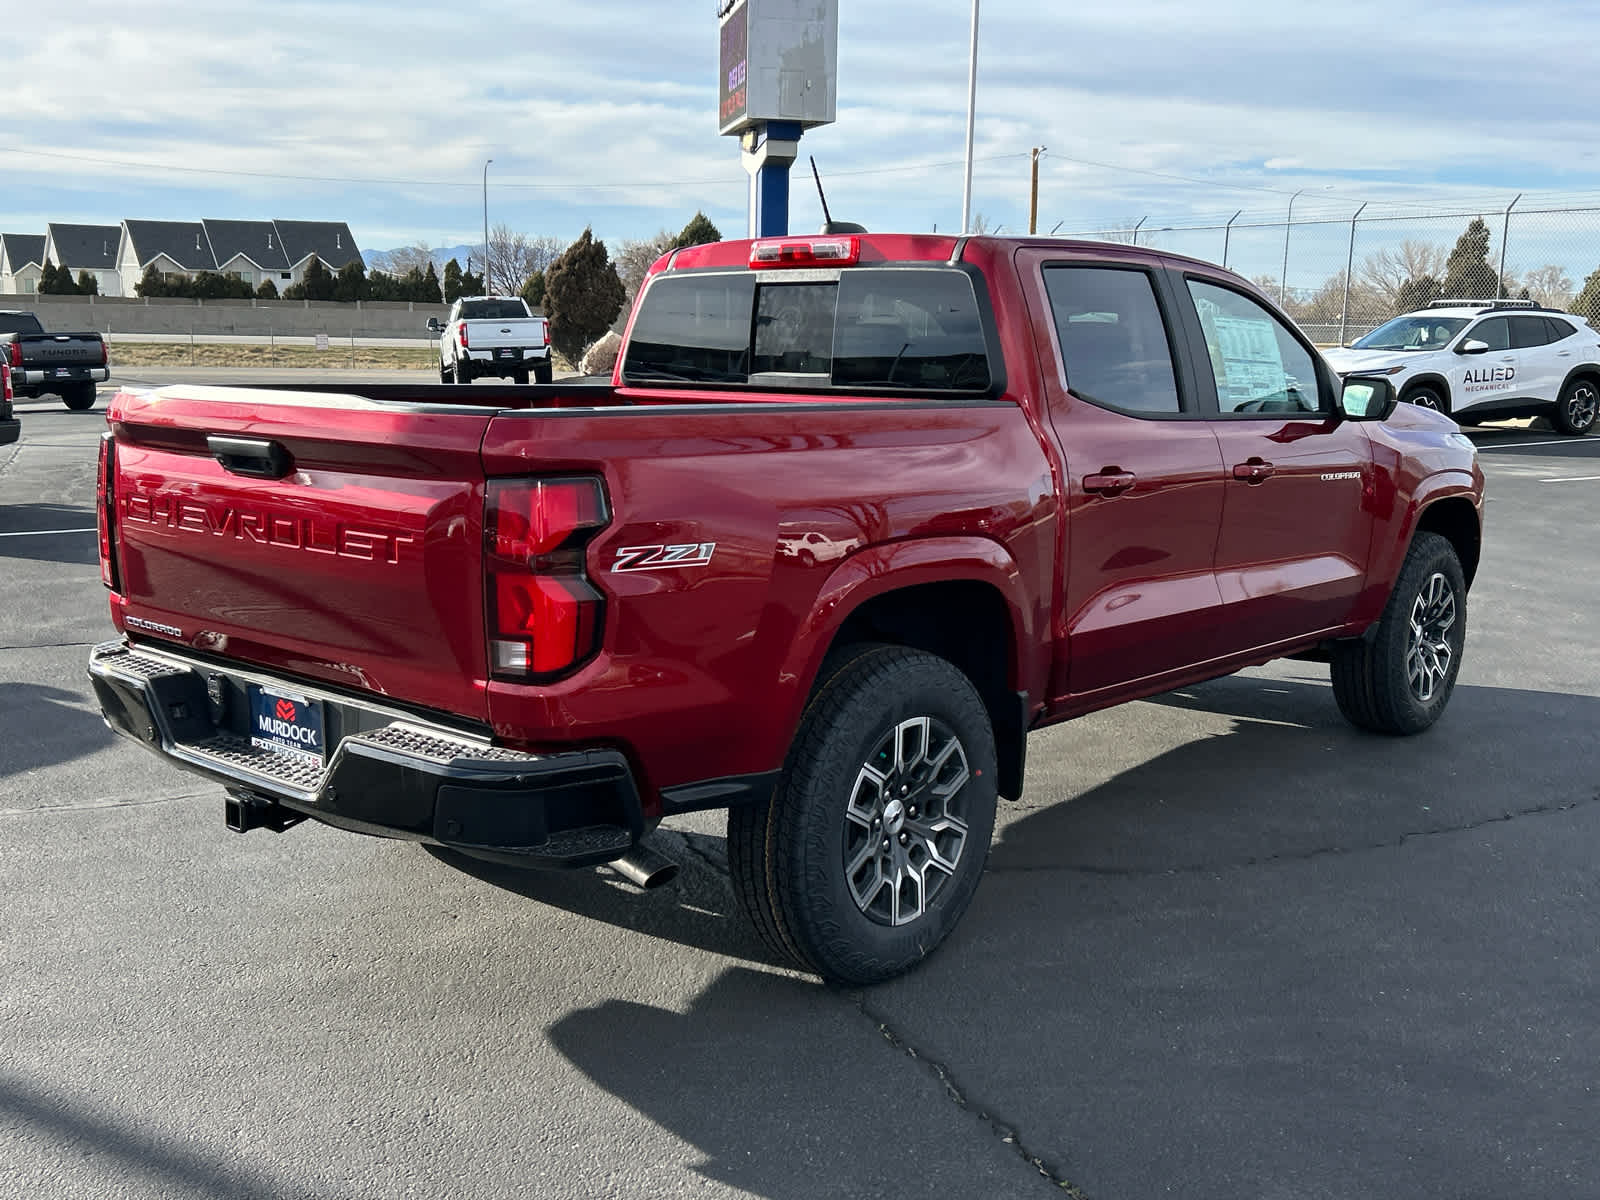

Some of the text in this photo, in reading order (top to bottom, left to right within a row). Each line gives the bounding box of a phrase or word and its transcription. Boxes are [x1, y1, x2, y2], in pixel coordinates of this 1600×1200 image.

[1463, 367, 1515, 384] ALLIED
[1465, 383, 1512, 392] MECHANICAL
[1320, 471, 1361, 481] COLORADO
[126, 496, 414, 565] CHEVROLET
[610, 542, 716, 573] Z71
[125, 615, 182, 637] COLORADO
[259, 714, 317, 746] MURDOCK
[272, 735, 301, 749] AUTO TEAM
